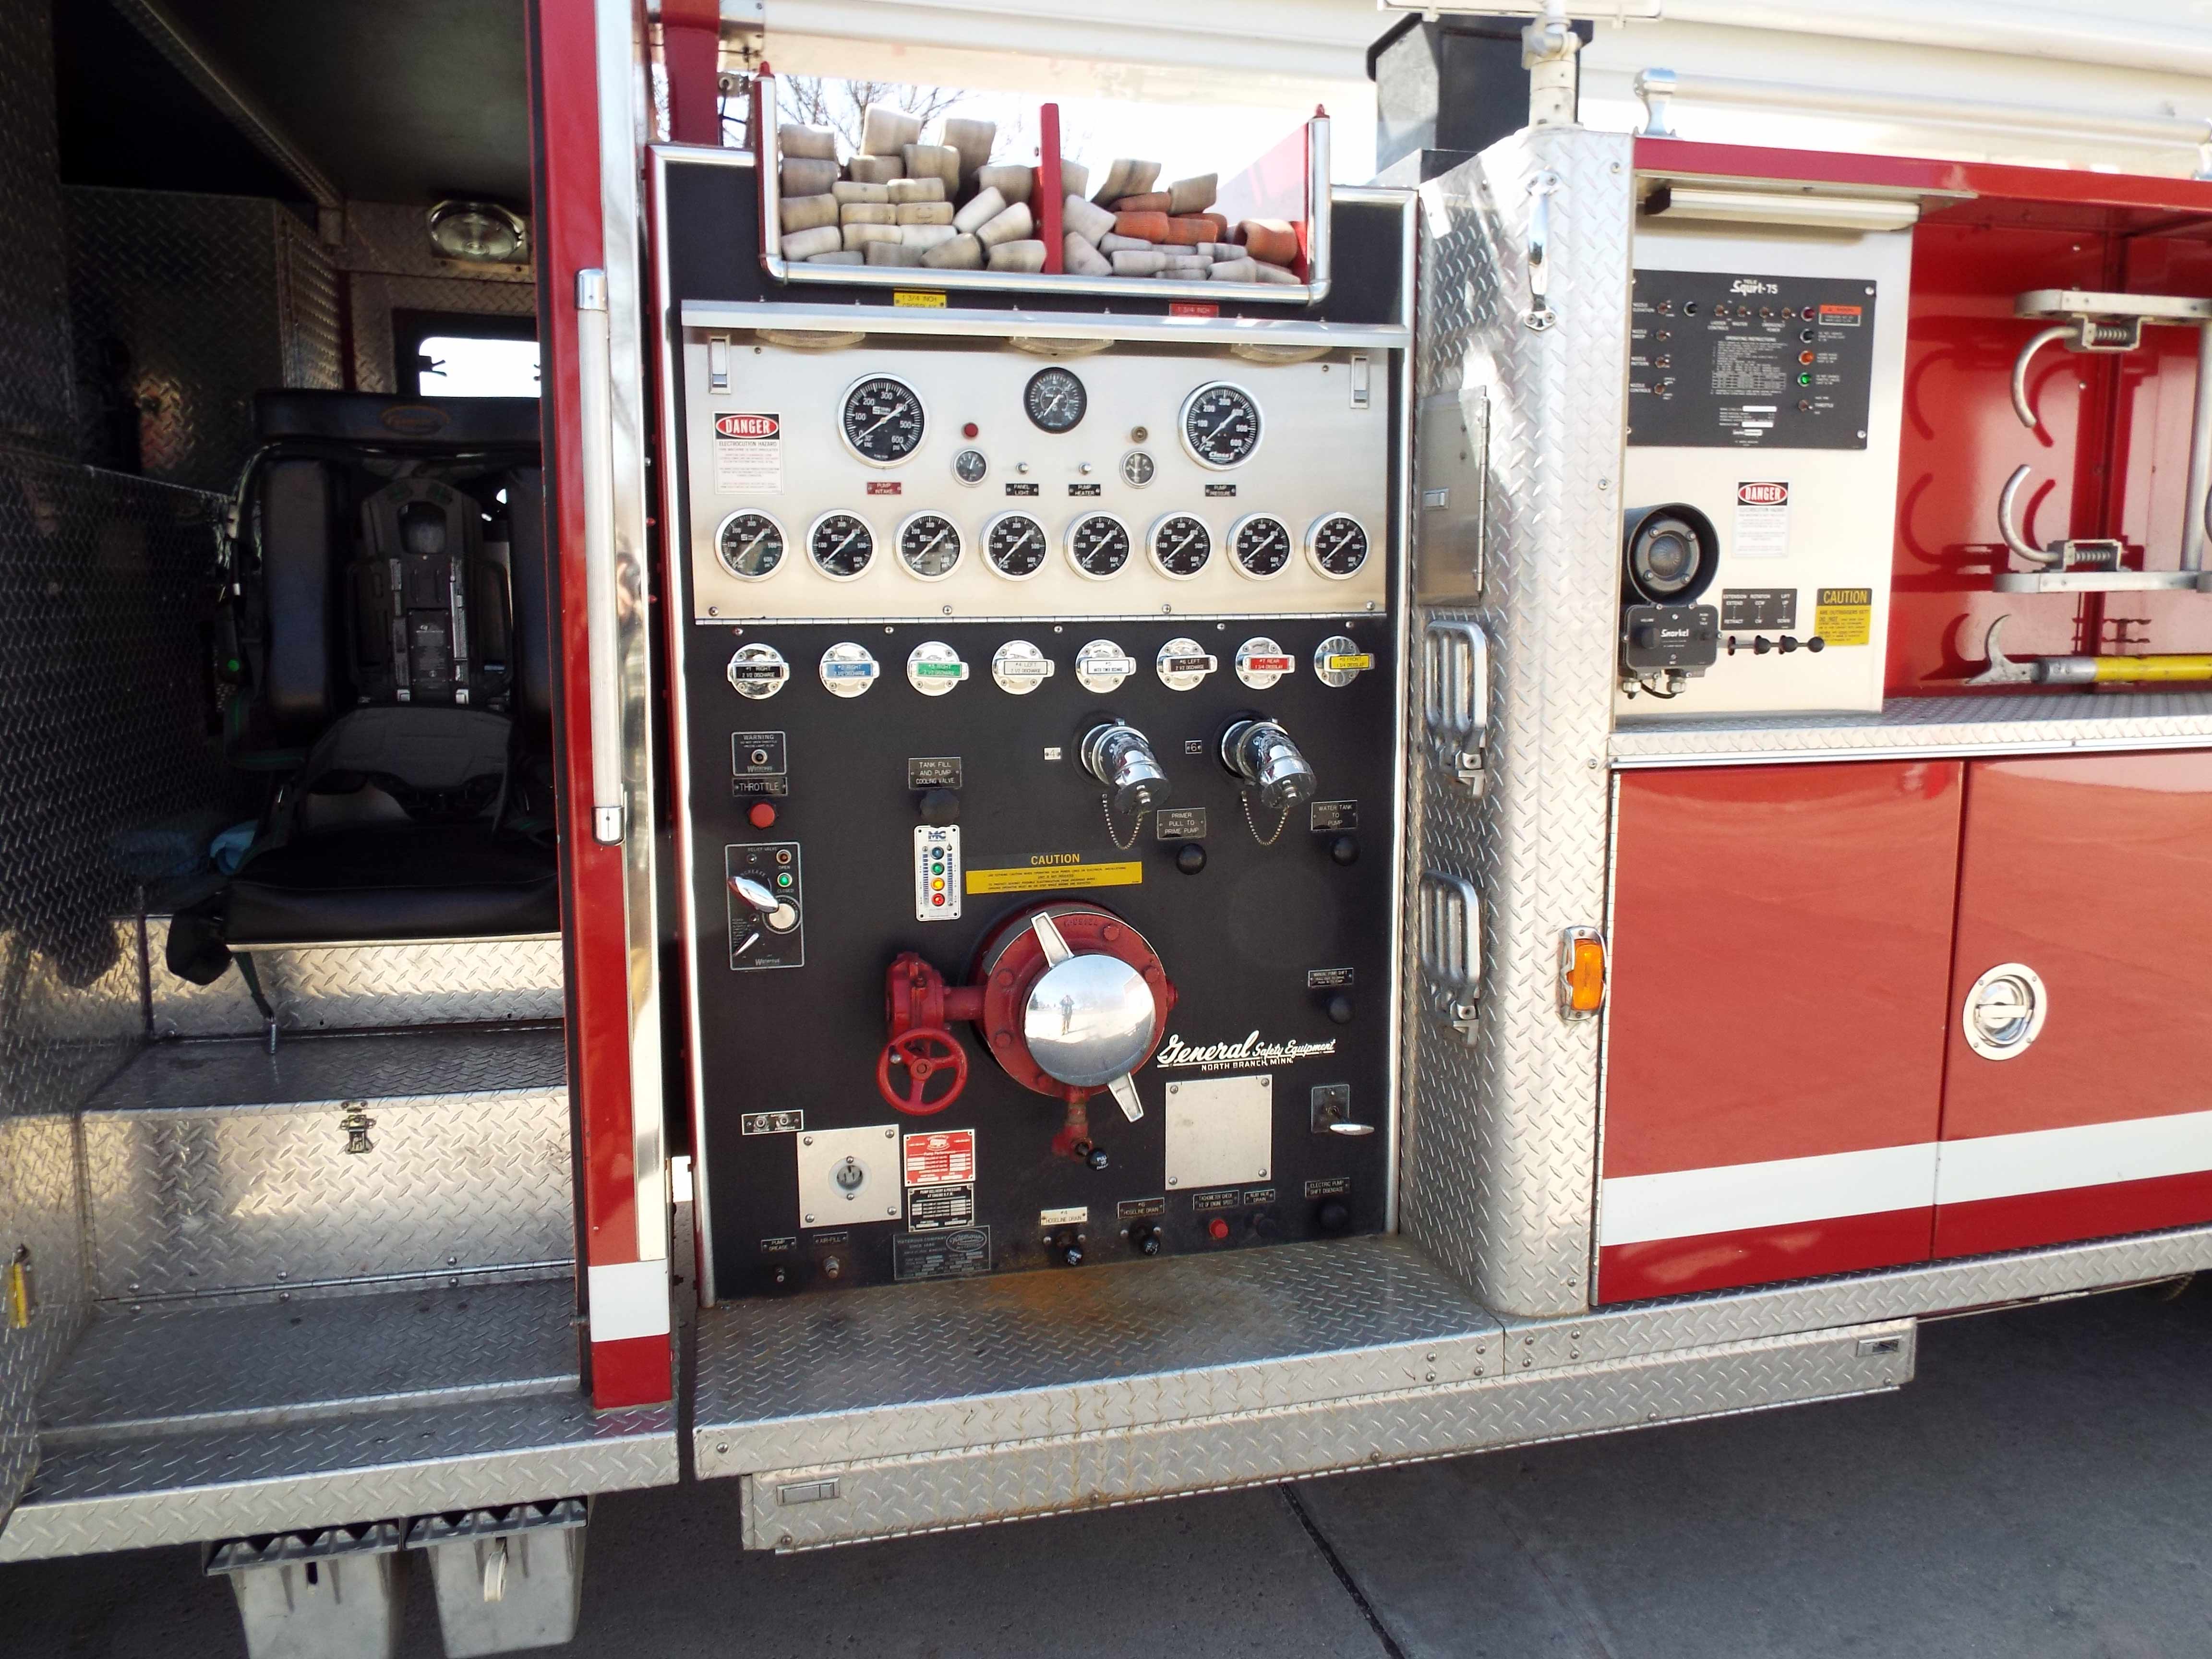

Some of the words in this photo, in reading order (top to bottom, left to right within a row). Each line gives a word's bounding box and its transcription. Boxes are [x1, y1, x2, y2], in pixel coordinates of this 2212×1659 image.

[725, 419, 770, 434] DANGER
[1745, 486, 1781, 500] DANGER
[1824, 590, 1867, 603] CAUTION
[1661, 629, 1690, 637] Snorkel
[1190, 743, 1197, 751] 6
[739, 782, 779, 791] THROTTLE
[1031, 854, 1080, 865] CAUTION
[1157, 1030, 1259, 1064] General
[1252, 1042, 1285, 1059] Safety
[1285, 1039, 1335, 1057] Equipment
[1201, 1063, 1229, 1071] NORTH
[1233, 1060, 1268, 1069] BRANCH,
